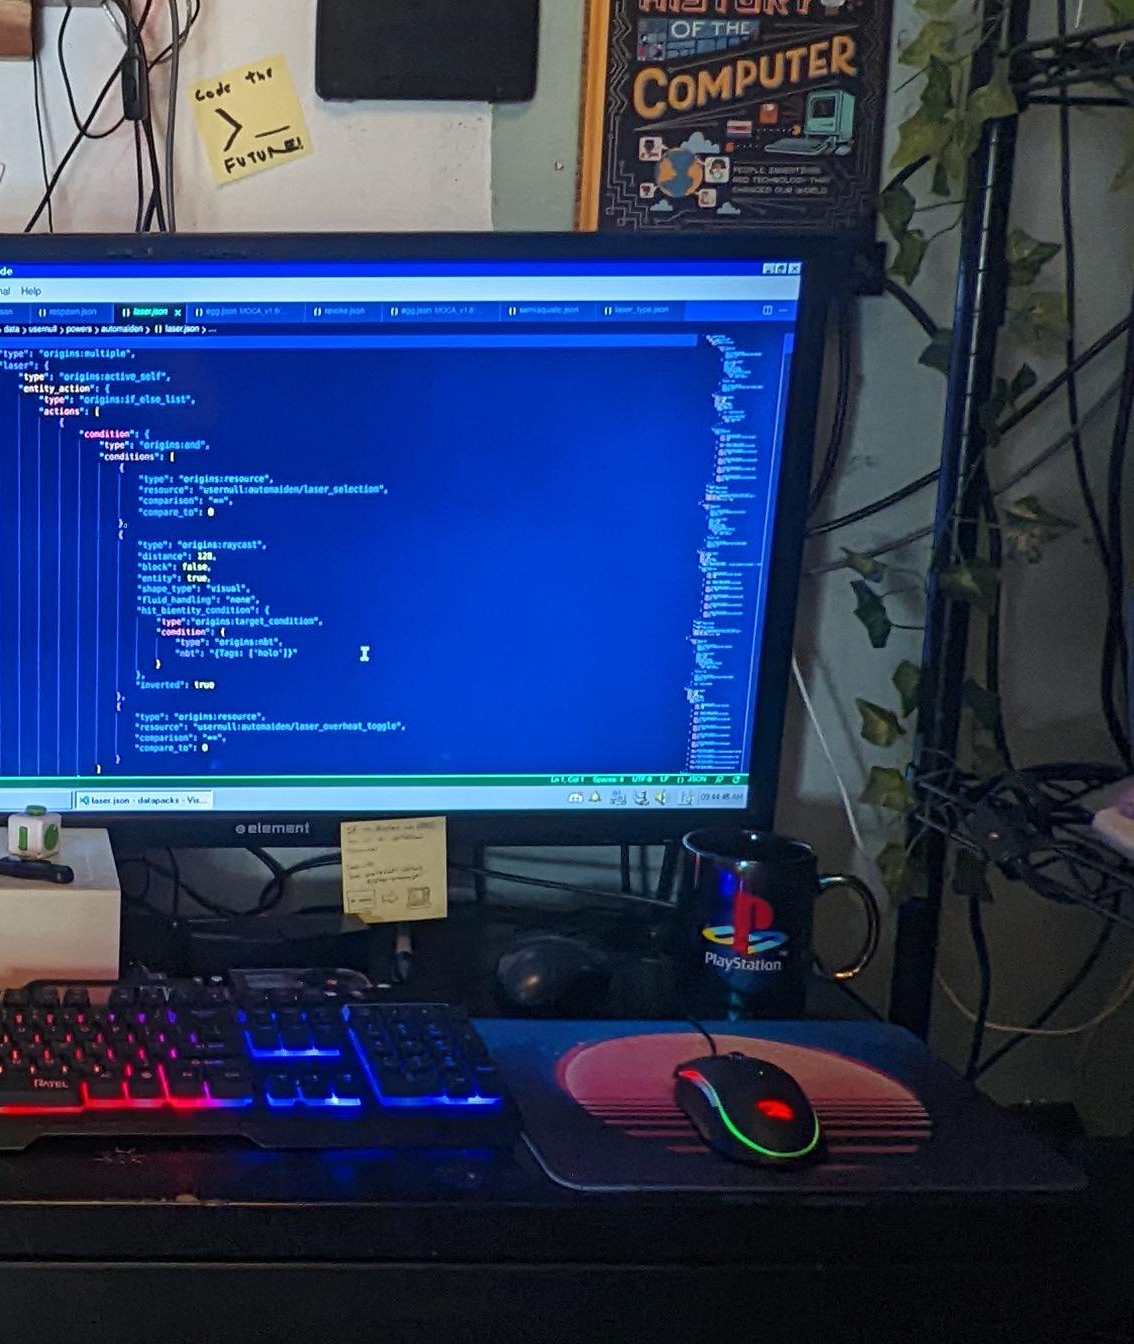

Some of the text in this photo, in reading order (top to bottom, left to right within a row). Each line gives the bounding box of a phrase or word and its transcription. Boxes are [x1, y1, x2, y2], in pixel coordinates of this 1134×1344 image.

[670, 19, 751, 39] OF THE
[634, 36, 858, 120] COMPUTER
[195, 82, 230, 102] Code
[224, 137, 304, 173] FUTURE!
[21, 287, 41, 298] Help
[4, 324, 20, 333] data
[66, 325, 92, 335] powers
[137, 796, 179, 805] datapacks
[247, 822, 309, 833] element
[705, 952, 782, 972] PlayStation
